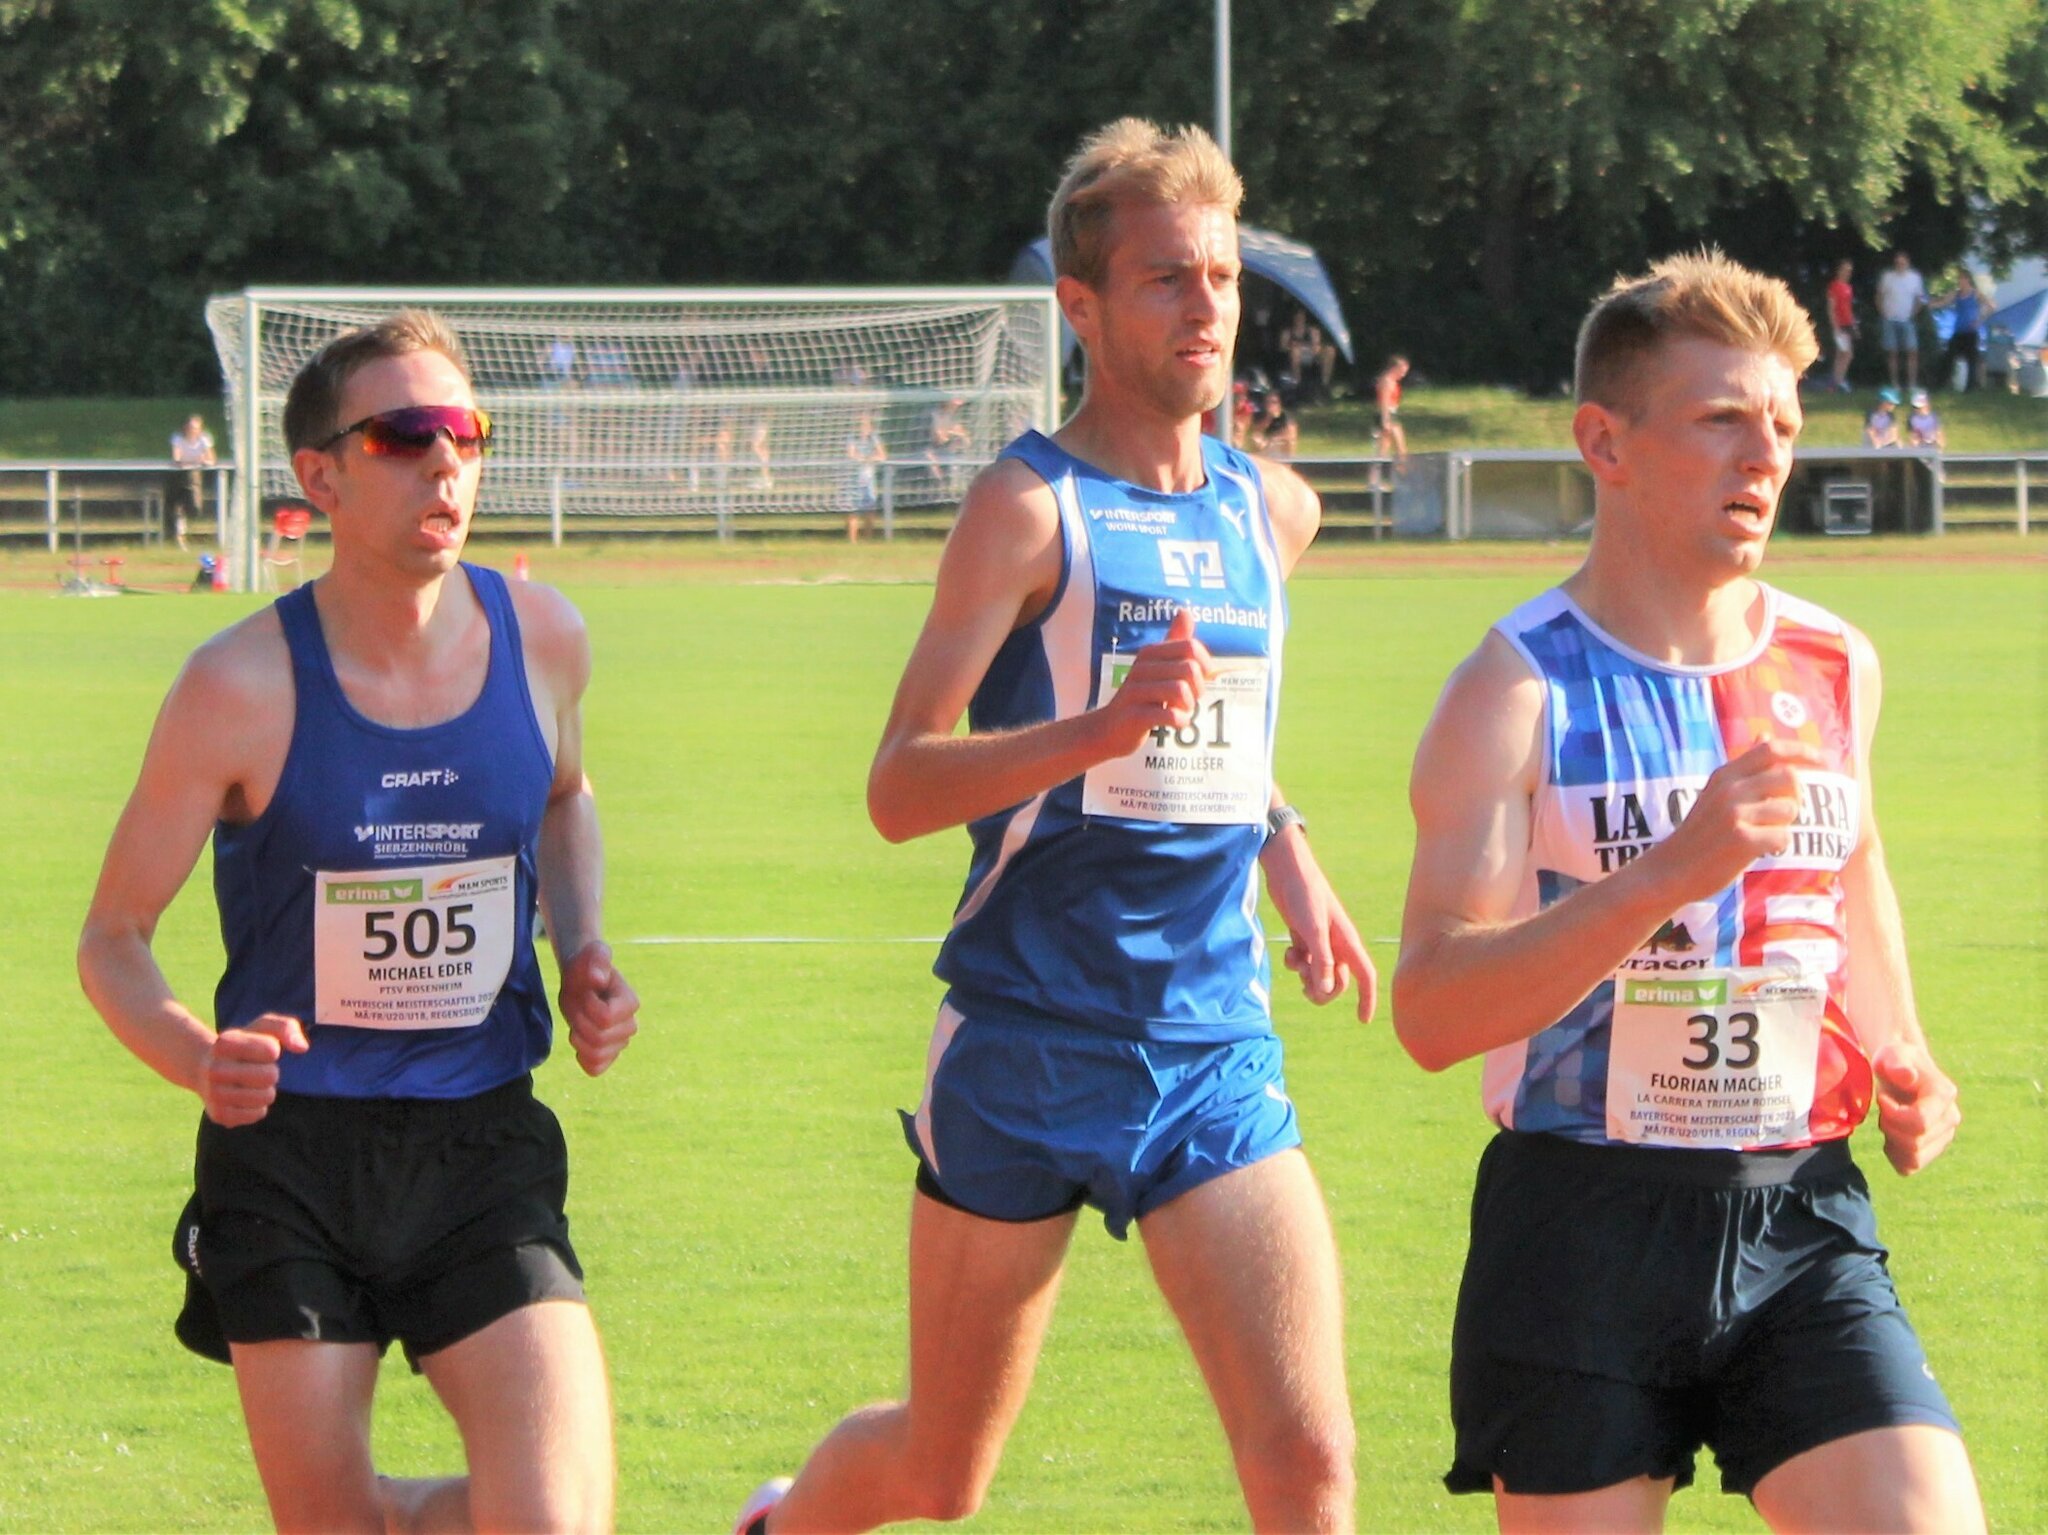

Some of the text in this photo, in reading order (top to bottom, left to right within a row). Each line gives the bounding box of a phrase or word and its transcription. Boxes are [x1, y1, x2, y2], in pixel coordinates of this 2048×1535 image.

[1104, 509, 1176, 524] INTERSPORT
[1145, 755, 1224, 770] MARIO LESER
[381, 770, 443, 788] CRAFT
[1108, 785, 1160, 799] BAYERISCHE
[1161, 791, 1228, 801] MEISTERSCHAFTEN
[1589, 793, 1653, 843] LA
[375, 823, 482, 842] INTERSPORT
[374, 841, 469, 856] SIEBZEHNRÜBL
[335, 886, 391, 901] erima
[363, 903, 477, 962] 505
[368, 962, 473, 981] MICHAEL EDER
[379, 982, 463, 995] PTSV ROSENHEIM
[1635, 985, 1695, 1002] erima
[340, 998, 394, 1010] BAYERISCHE
[396, 995, 476, 1009] MEISTERSCHAFTEN
[431, 1005, 486, 1019] REGENSBURG
[1682, 1011, 1760, 1071] 33
[1651, 1073, 1782, 1093] FLORIAN MACHER
[1637, 1092, 1791, 1108] LA CARRERA TRITEAM ROTHSEE
[1630, 1111, 1687, 1124] BAYERISCHE
[1690, 1111, 1774, 1124] MEISTERSCHAFTEN
